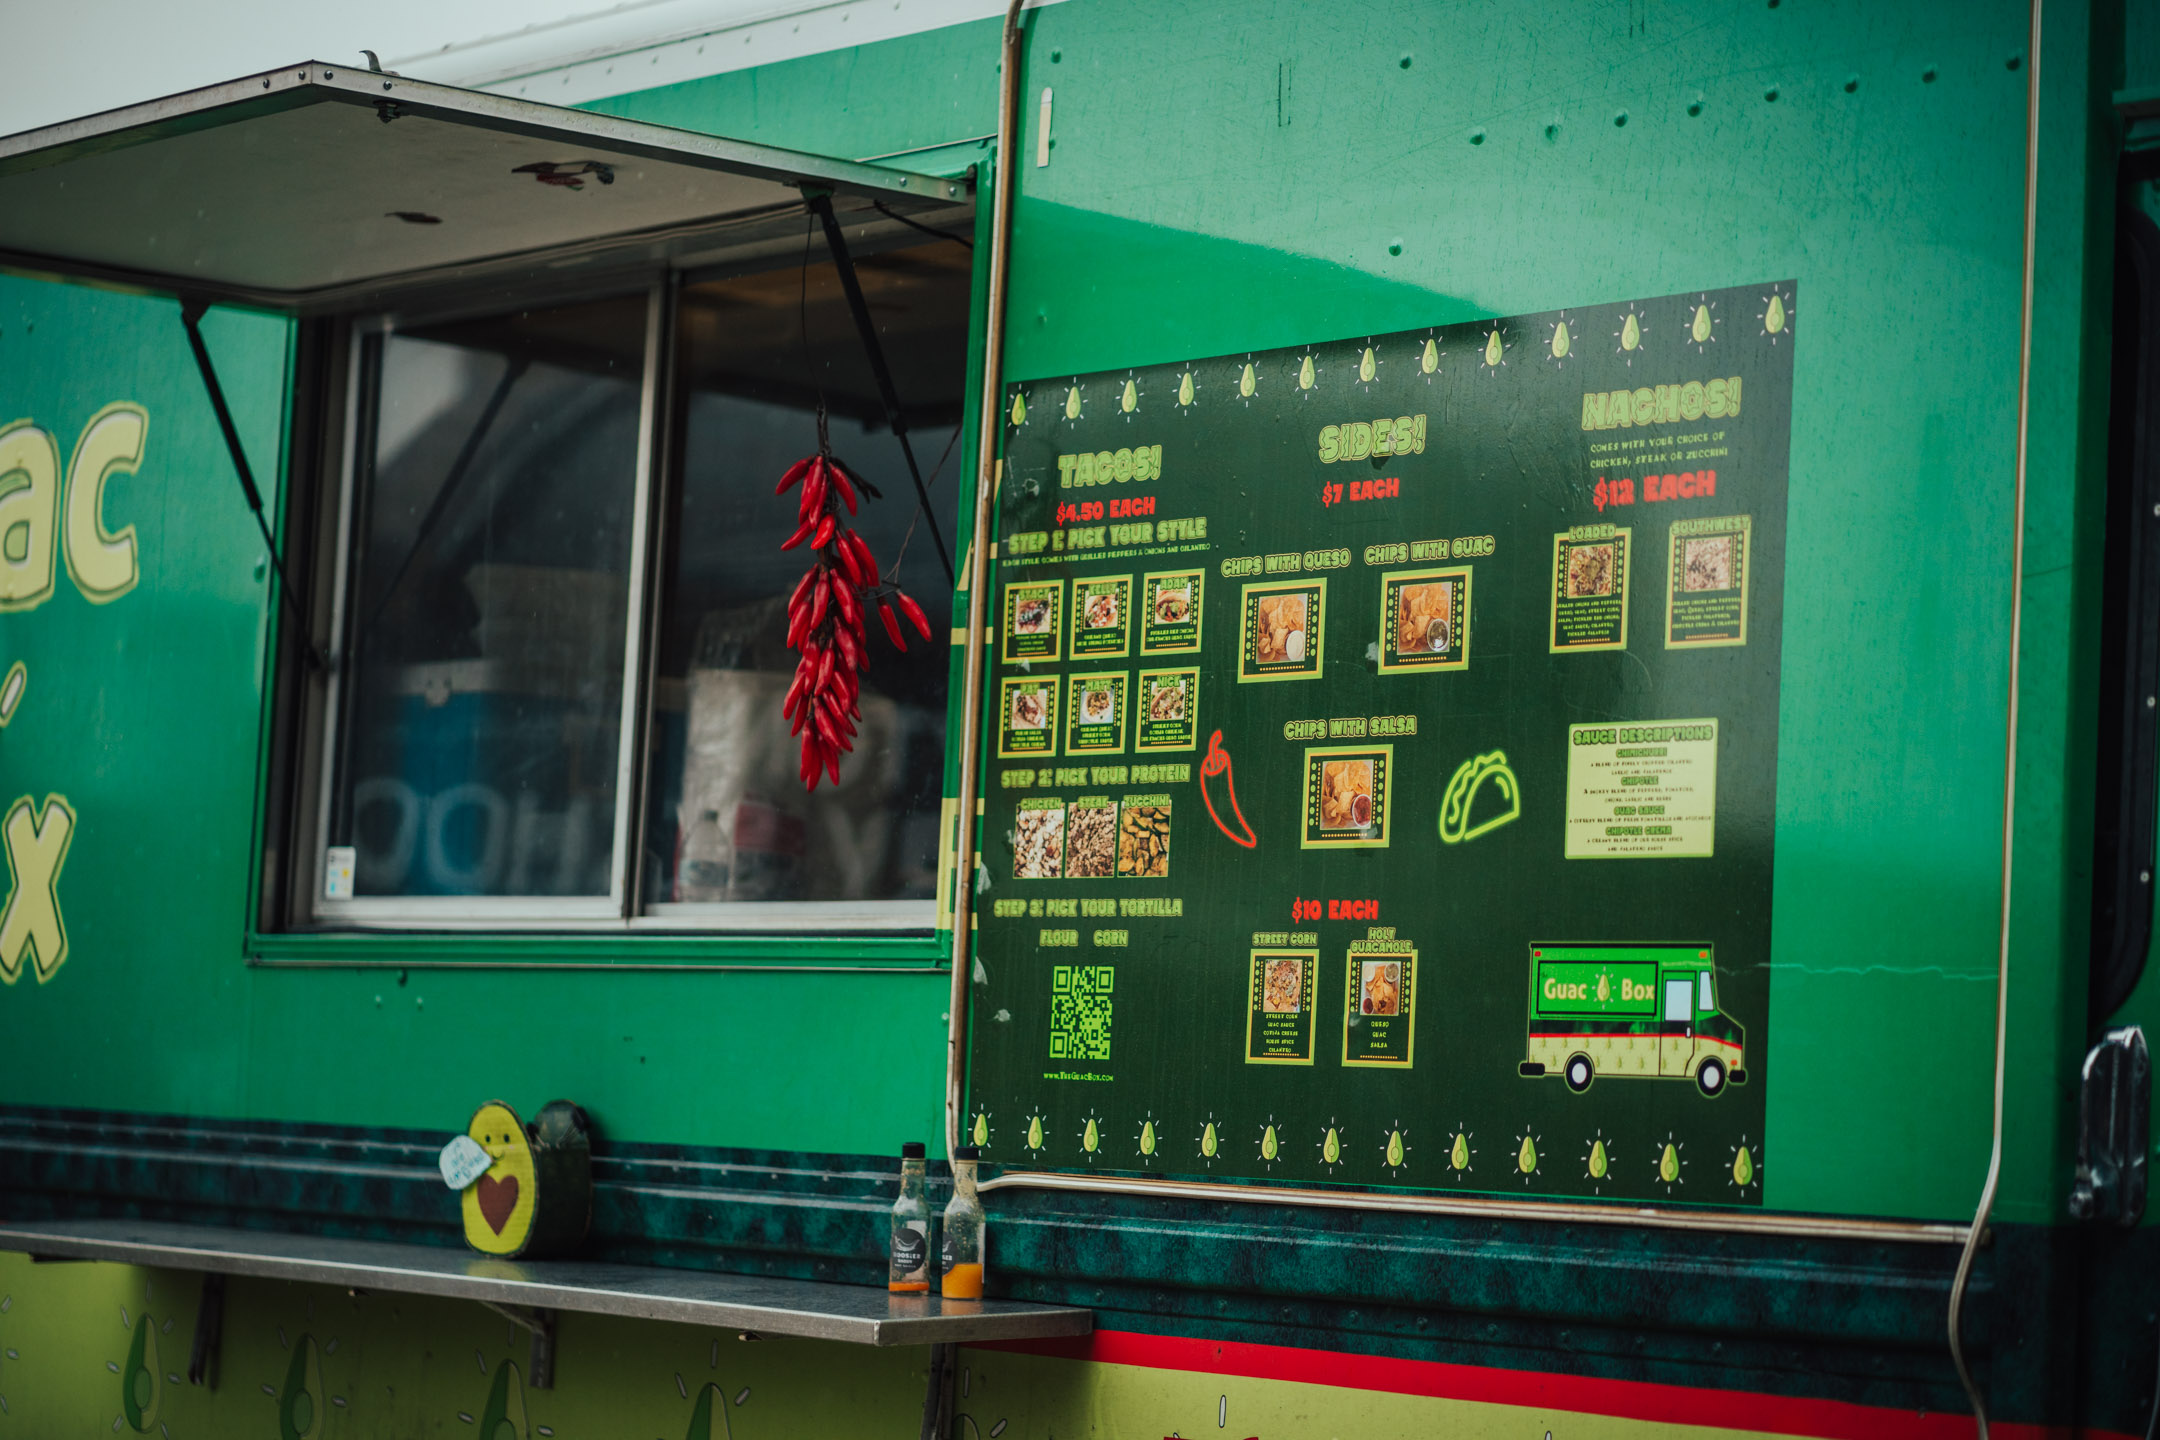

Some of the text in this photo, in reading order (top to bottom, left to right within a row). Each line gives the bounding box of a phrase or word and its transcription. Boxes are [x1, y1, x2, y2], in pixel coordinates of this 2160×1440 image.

[1582, 376, 1742, 430] NACHOS!
[1318, 414, 1426, 464] SIDES!
[1590, 431, 1726, 453] COMES WITH YOUR CHOICE OF
[1058, 444, 1162, 488] TACOS!
[1590, 448, 1728, 468] CHICKEN, STEAK OR ZUCCHINI
[1322, 478, 1400, 508] $7 EACH
[1593, 470, 1716, 513] $12 EACH
[1056, 496, 1156, 527] $4.50 EACH
[1008, 531, 1048, 554] STEP
[1068, 526, 1106, 550] PICK
[1110, 522, 1154, 546] YOUR
[1157, 516, 1207, 542] STYLE
[1568, 523, 1616, 542] LOADED
[1671, 514, 1752, 536] SOUTHWEST
[1364, 535, 1495, 565] CHIPS WITH GUAC
[1221, 548, 1351, 577] CHIPS WITH QUESO
[1160, 576, 1188, 590] ADAM
[1157, 674, 1181, 688] NICK
[1284, 715, 1417, 740] CHIPS WITH SALSA
[1573, 725, 1714, 746] SAUCE DESCRIPTIONS
[1001, 764, 1191, 788] STEP 2: PICK YOUR PROTEIN
[1020, 794, 1170, 810] CHICKEN STEAK ZUCCHINI
[994, 898, 1183, 918] STEP 3: PICK YOUR TORTILLA
[1292, 896, 1379, 924] $10 EACH
[1040, 929, 1128, 946] FLOUR CORN
[1252, 932, 1318, 946] STREET CORN
[1368, 926, 1396, 940] HOLY
[1350, 940, 1413, 954] GUACAMOLE
[1544, 978, 1654, 1000] Guac Box
